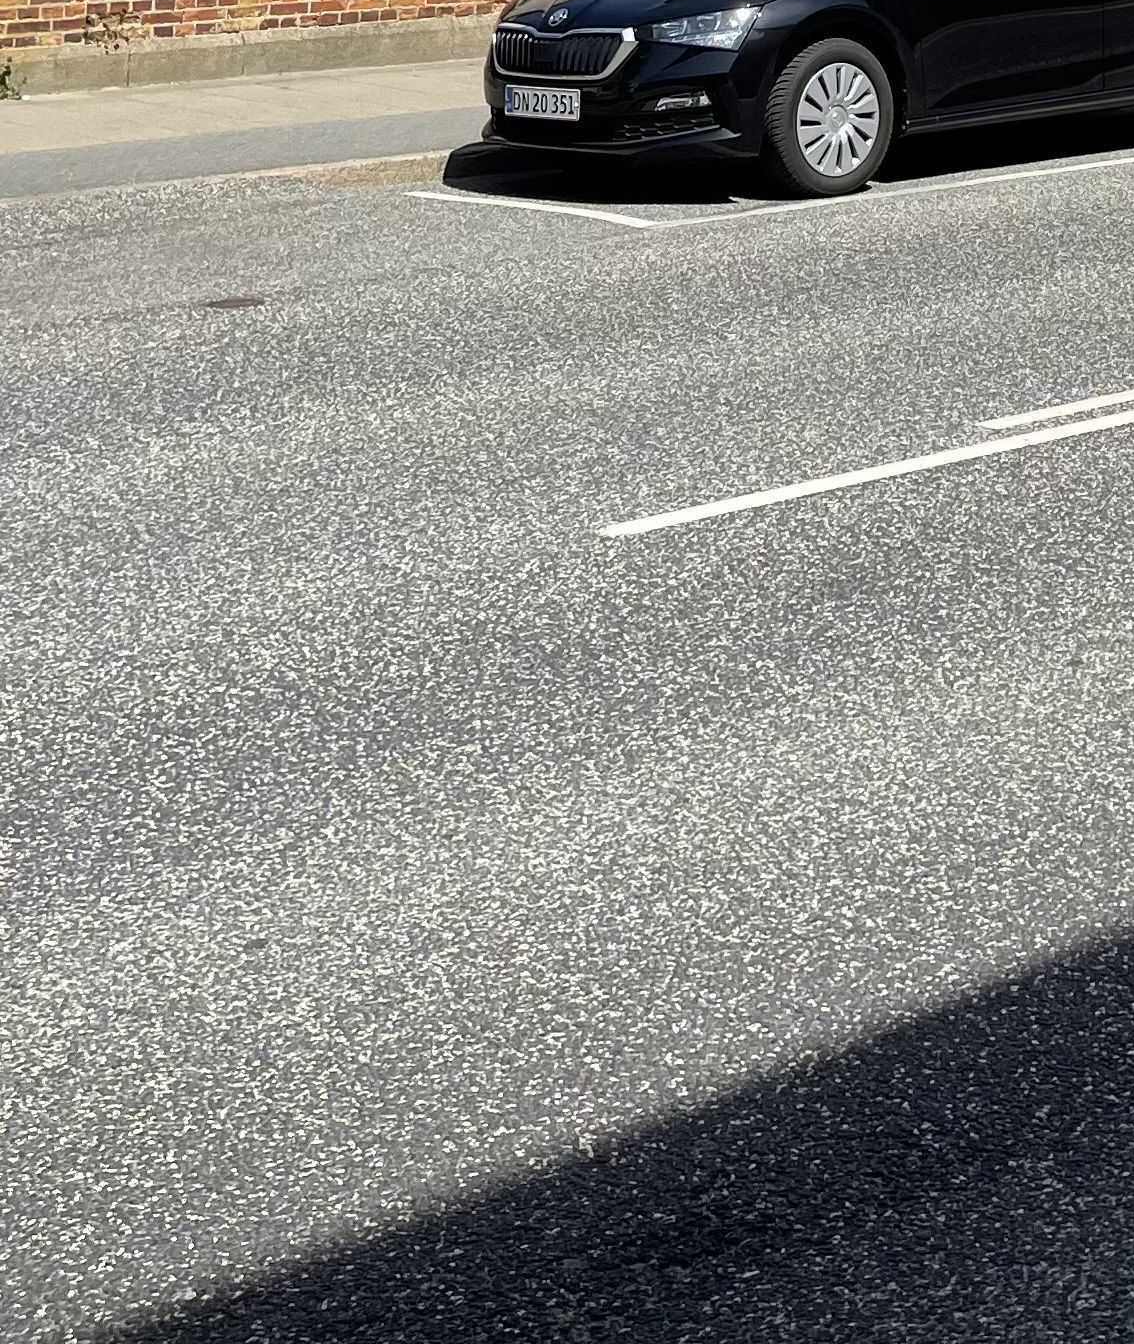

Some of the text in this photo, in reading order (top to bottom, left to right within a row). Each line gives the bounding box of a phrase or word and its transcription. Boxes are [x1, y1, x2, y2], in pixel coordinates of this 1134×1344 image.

[514, 91, 574, 115] DN 20 351
